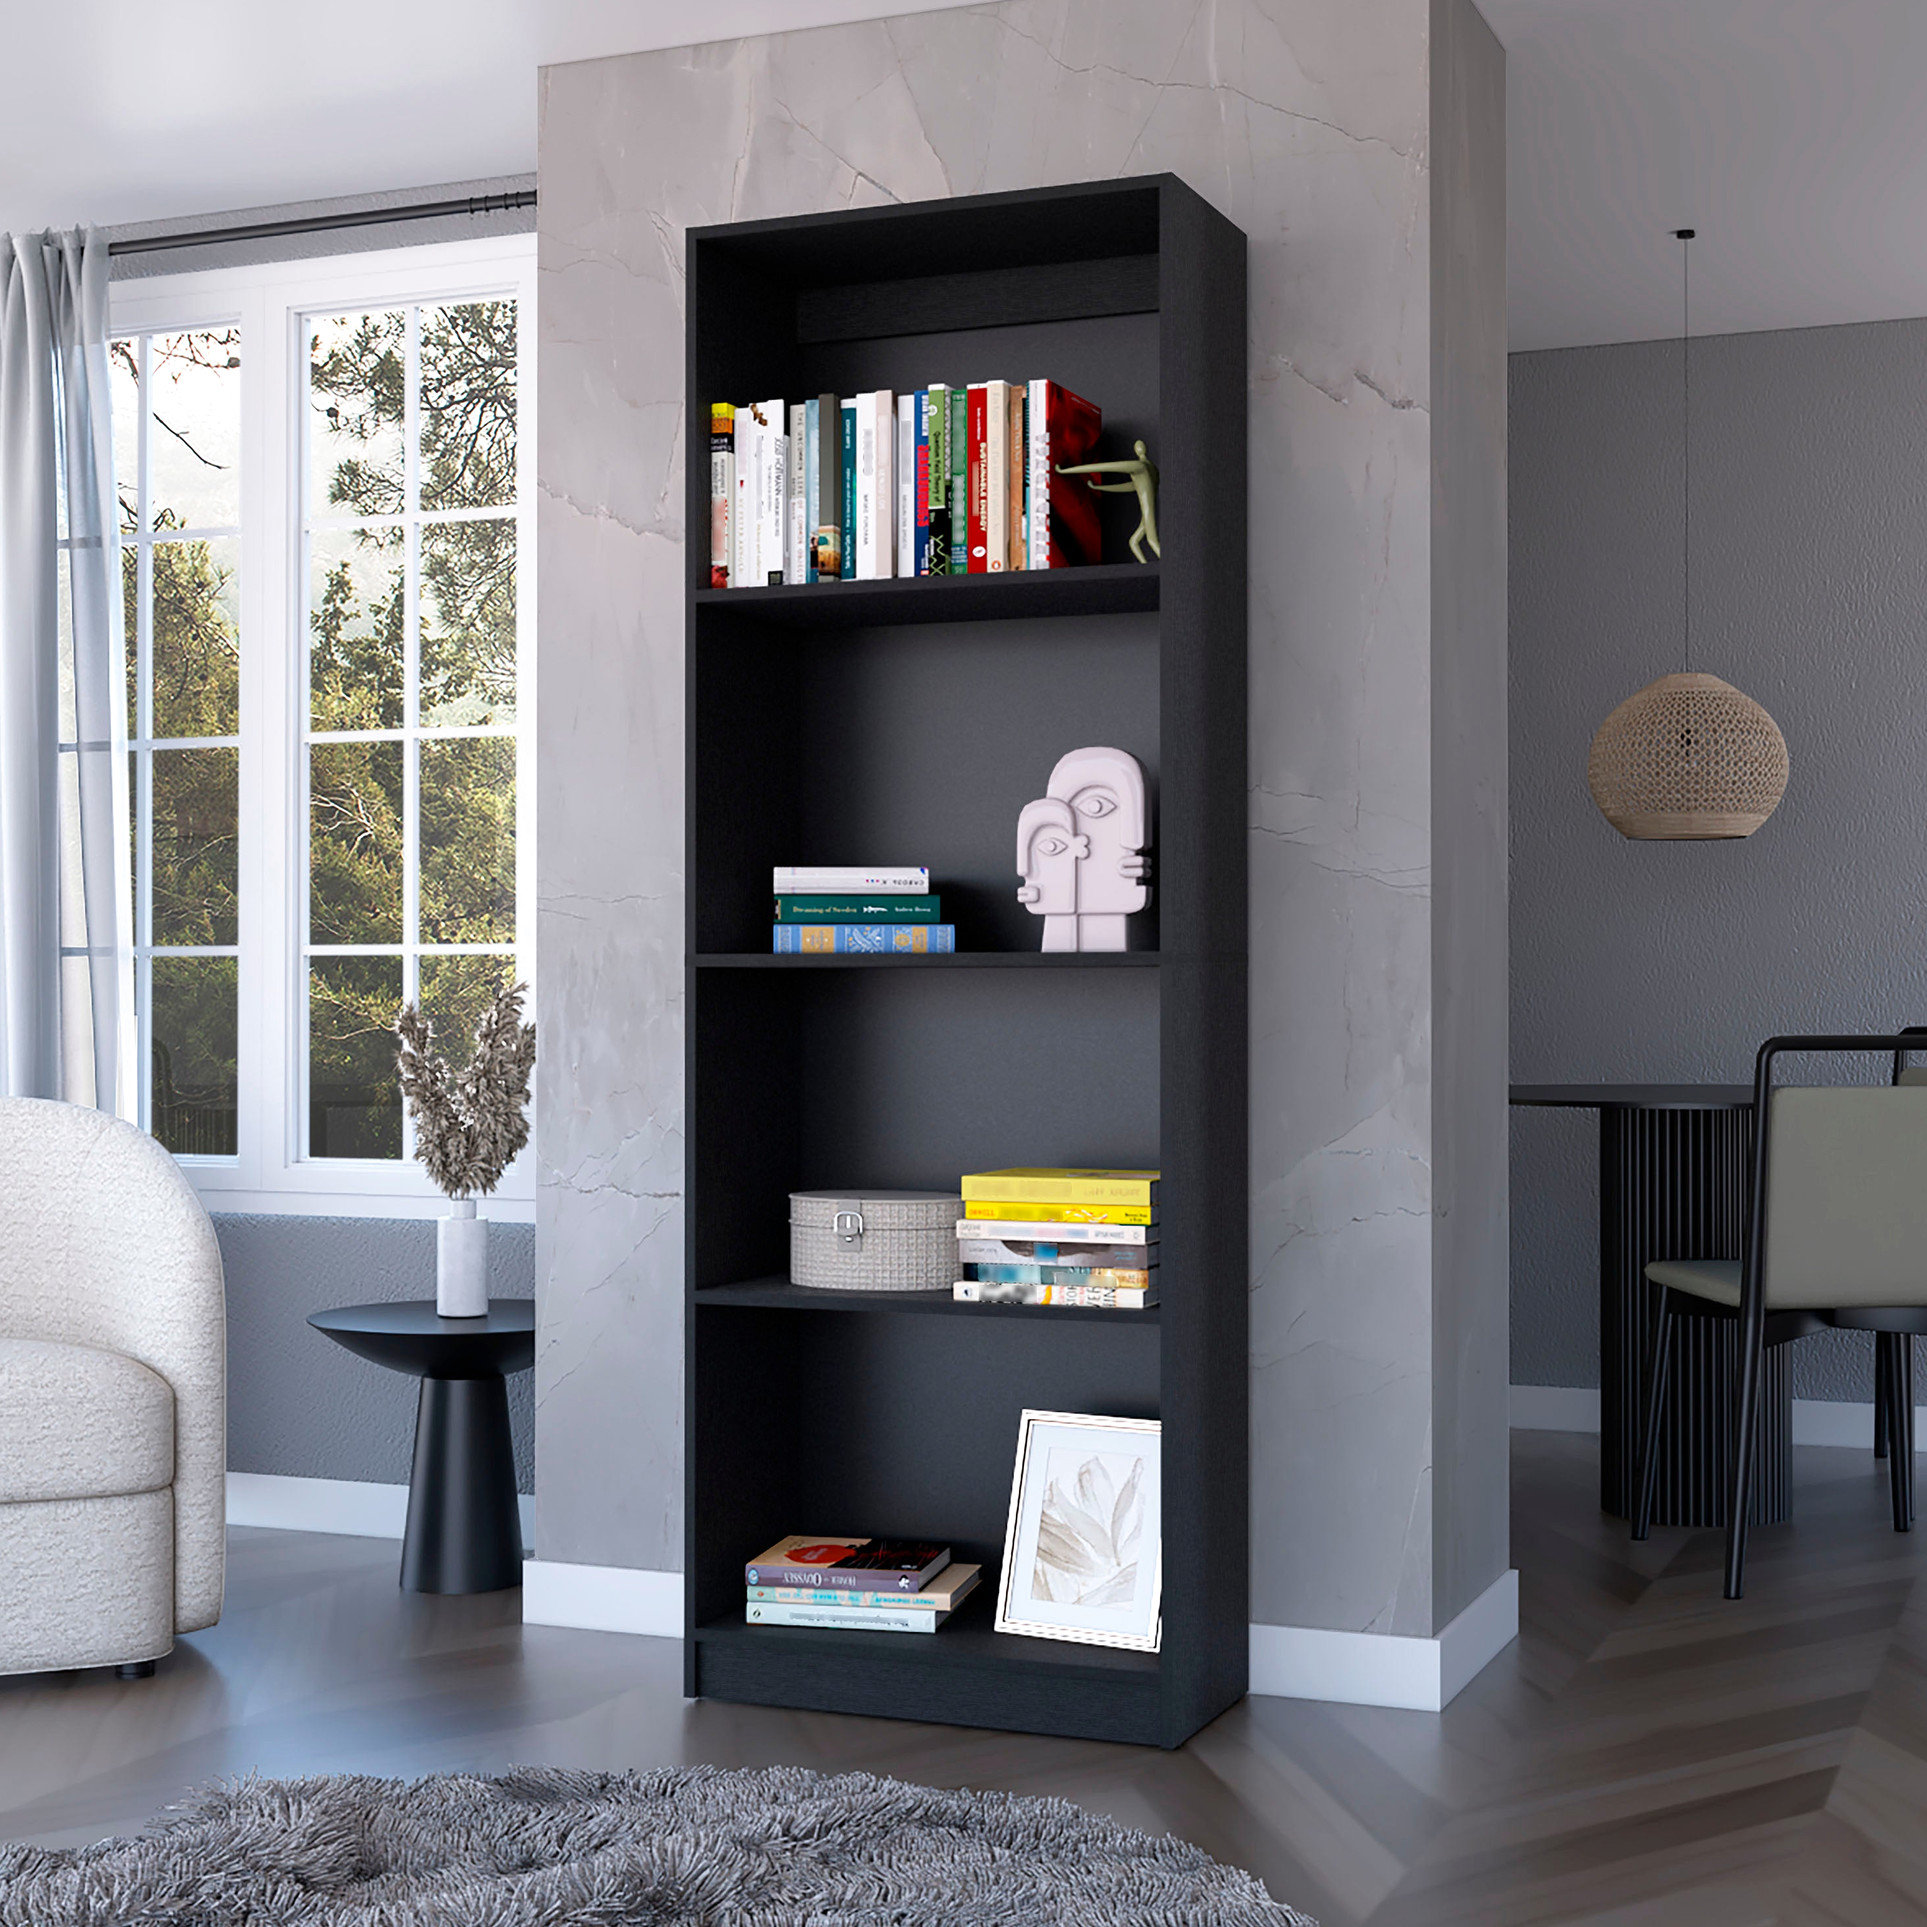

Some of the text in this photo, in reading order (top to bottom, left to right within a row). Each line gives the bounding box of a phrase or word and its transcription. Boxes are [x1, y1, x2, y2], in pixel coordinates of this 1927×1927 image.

[933, 431, 942, 458] Quantum
[934, 459, 942, 474] Field
[979, 442, 987, 498] SUSTAINABLE
[933, 475, 942, 494] Theory
[979, 498, 987, 532] ENERGY
[783, 1572, 822, 1587] ODYSSEY
